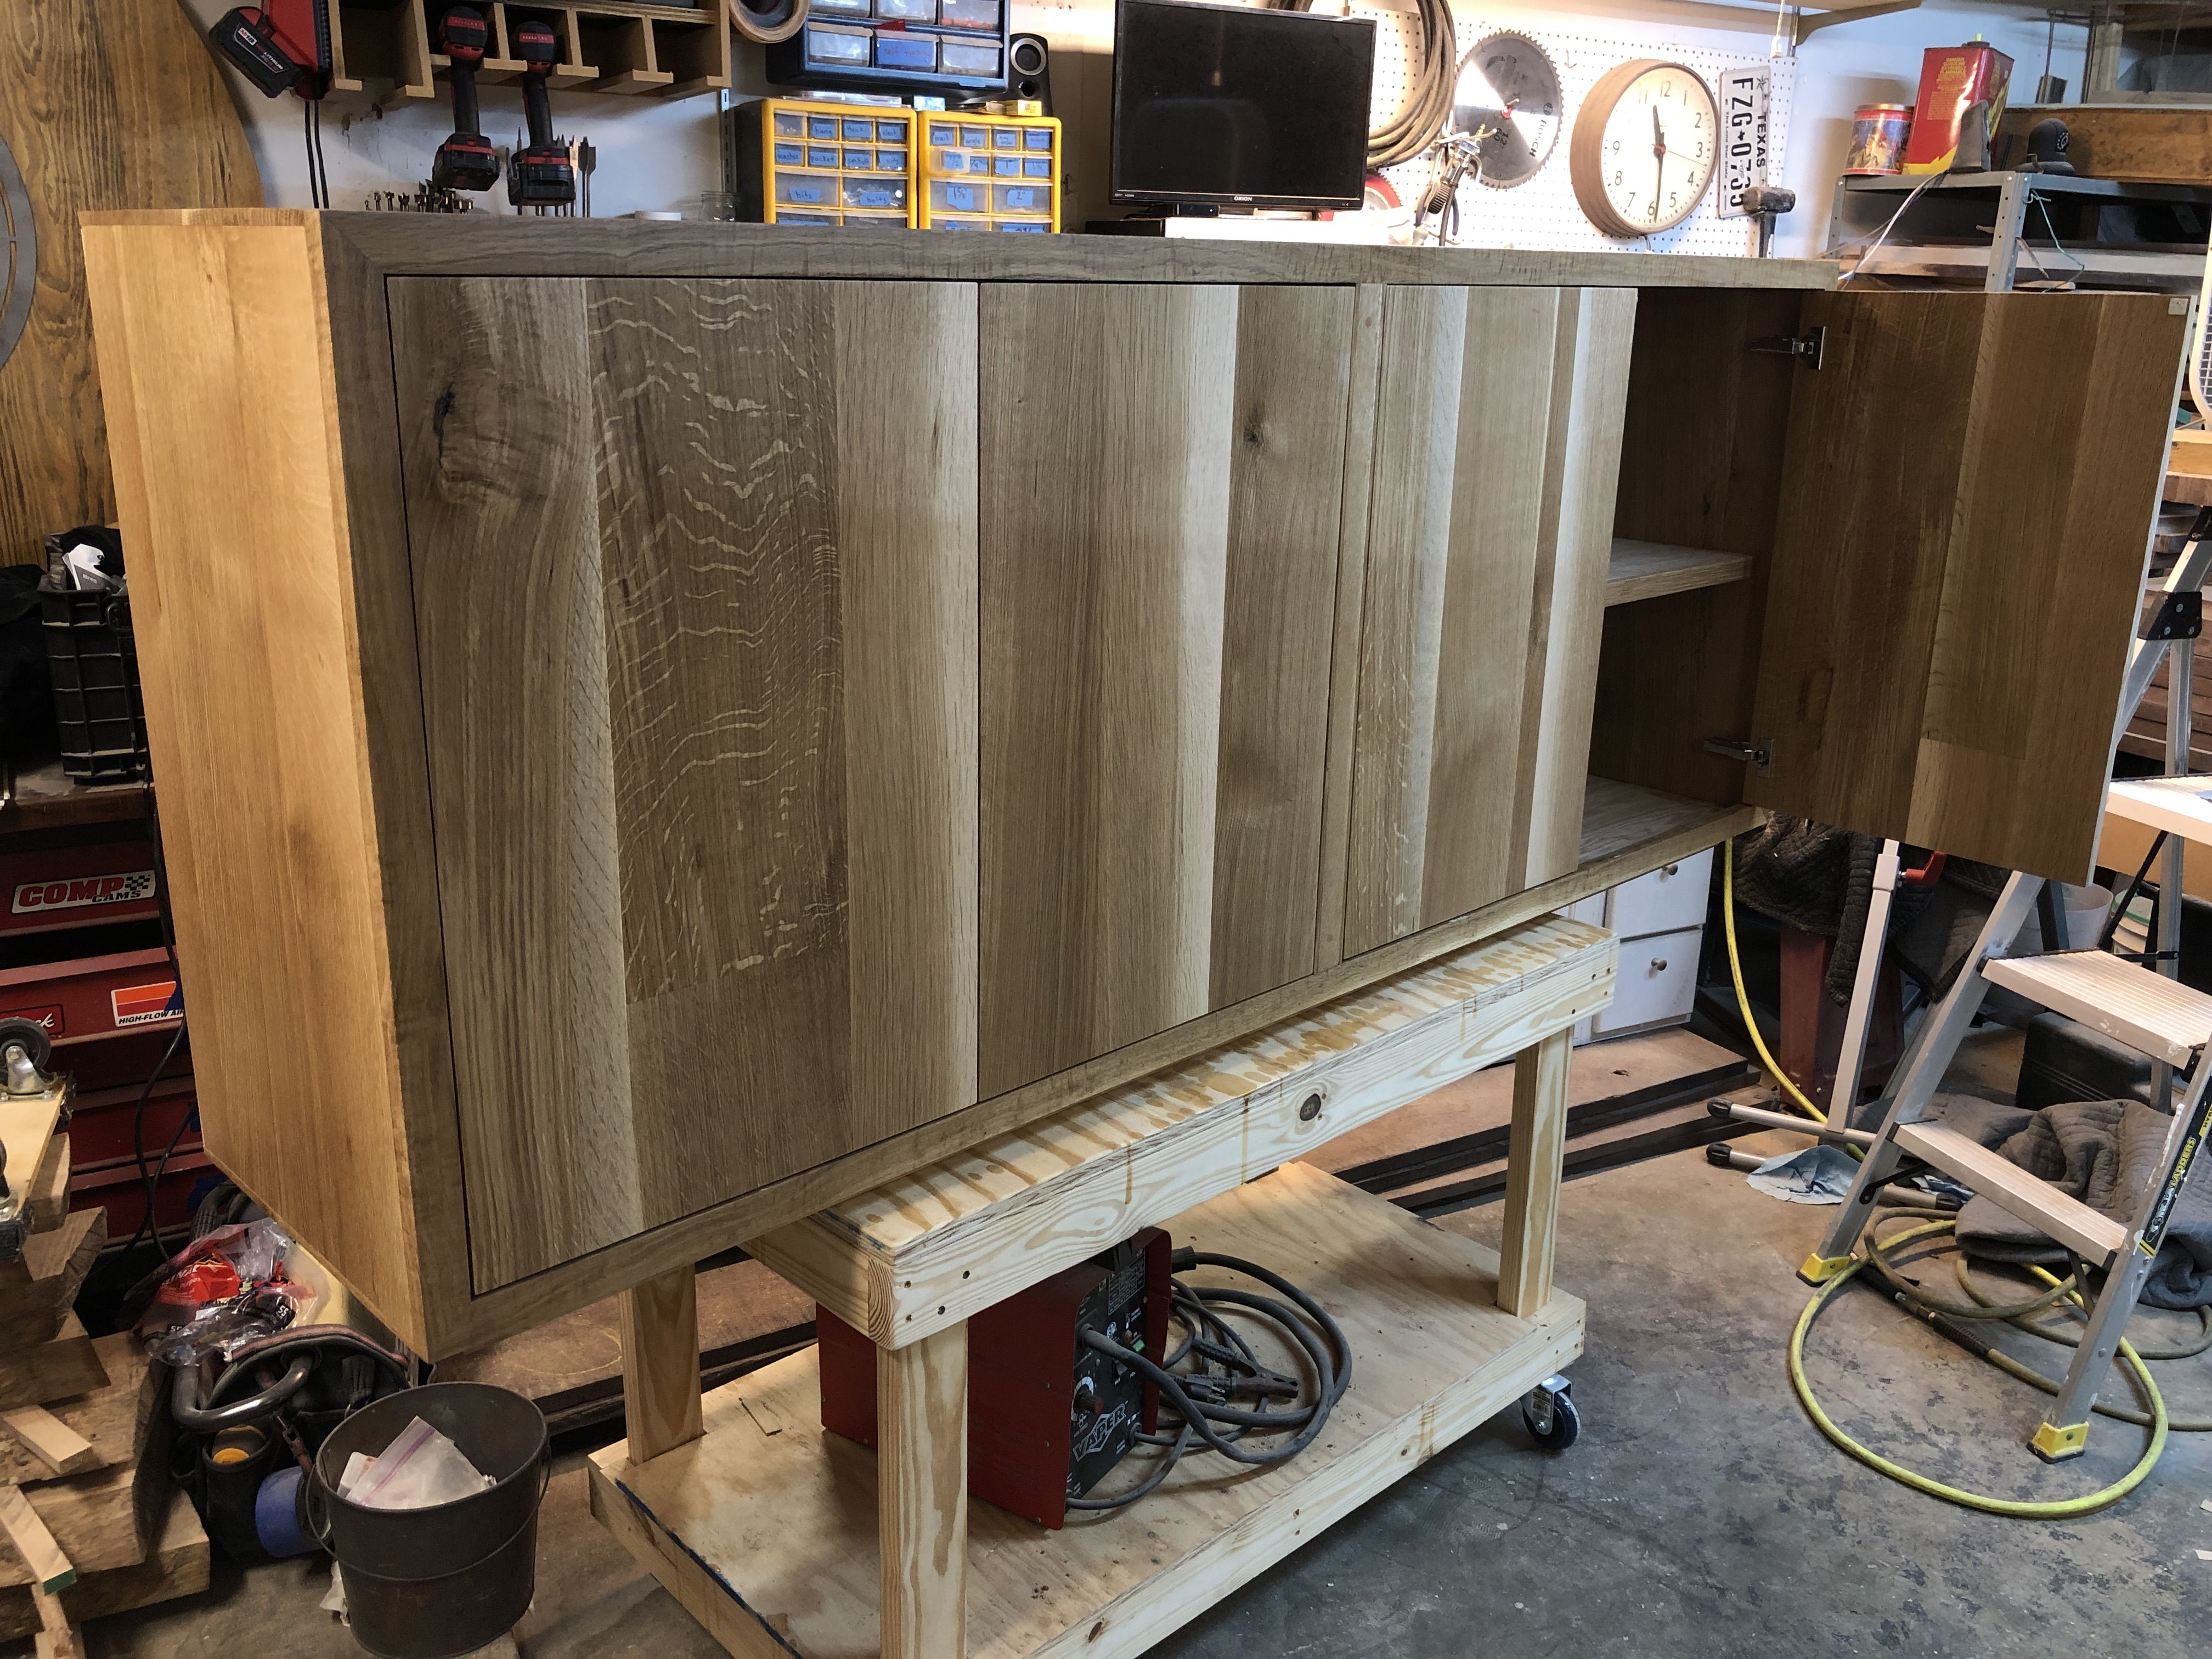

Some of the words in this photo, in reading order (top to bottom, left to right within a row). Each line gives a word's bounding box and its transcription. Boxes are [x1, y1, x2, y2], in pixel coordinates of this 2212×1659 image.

[1660, 81, 1672, 97] 12
[1683, 90, 1688, 106] 1
[1732, 77, 1753, 127] FZG
[1694, 112, 1702, 128] 2
[1529, 119, 1547, 157] BOSCH
[1756, 112, 1767, 168] TEXAS
[1612, 140, 1620, 156] 9
[1696, 142, 1703, 158] 3
[810, 155, 835, 165] pocket
[1615, 171, 1622, 186] 8
[1688, 171, 1695, 187] 4
[795, 191, 812, 199] bits
[866, 196, 888, 204] bolts
[1627, 192, 1636, 207] 7
[1669, 192, 1677, 208] 5
[1647, 201, 1656, 216] 6
[19, 877, 125, 907] COMP
[92, 890, 142, 902] CAMS
[119, 1010, 168, 1024] HIGH-FLOW
[2169, 1136, 2197, 1187] LADDERS
[1073, 1403, 1127, 1462] VAPER
